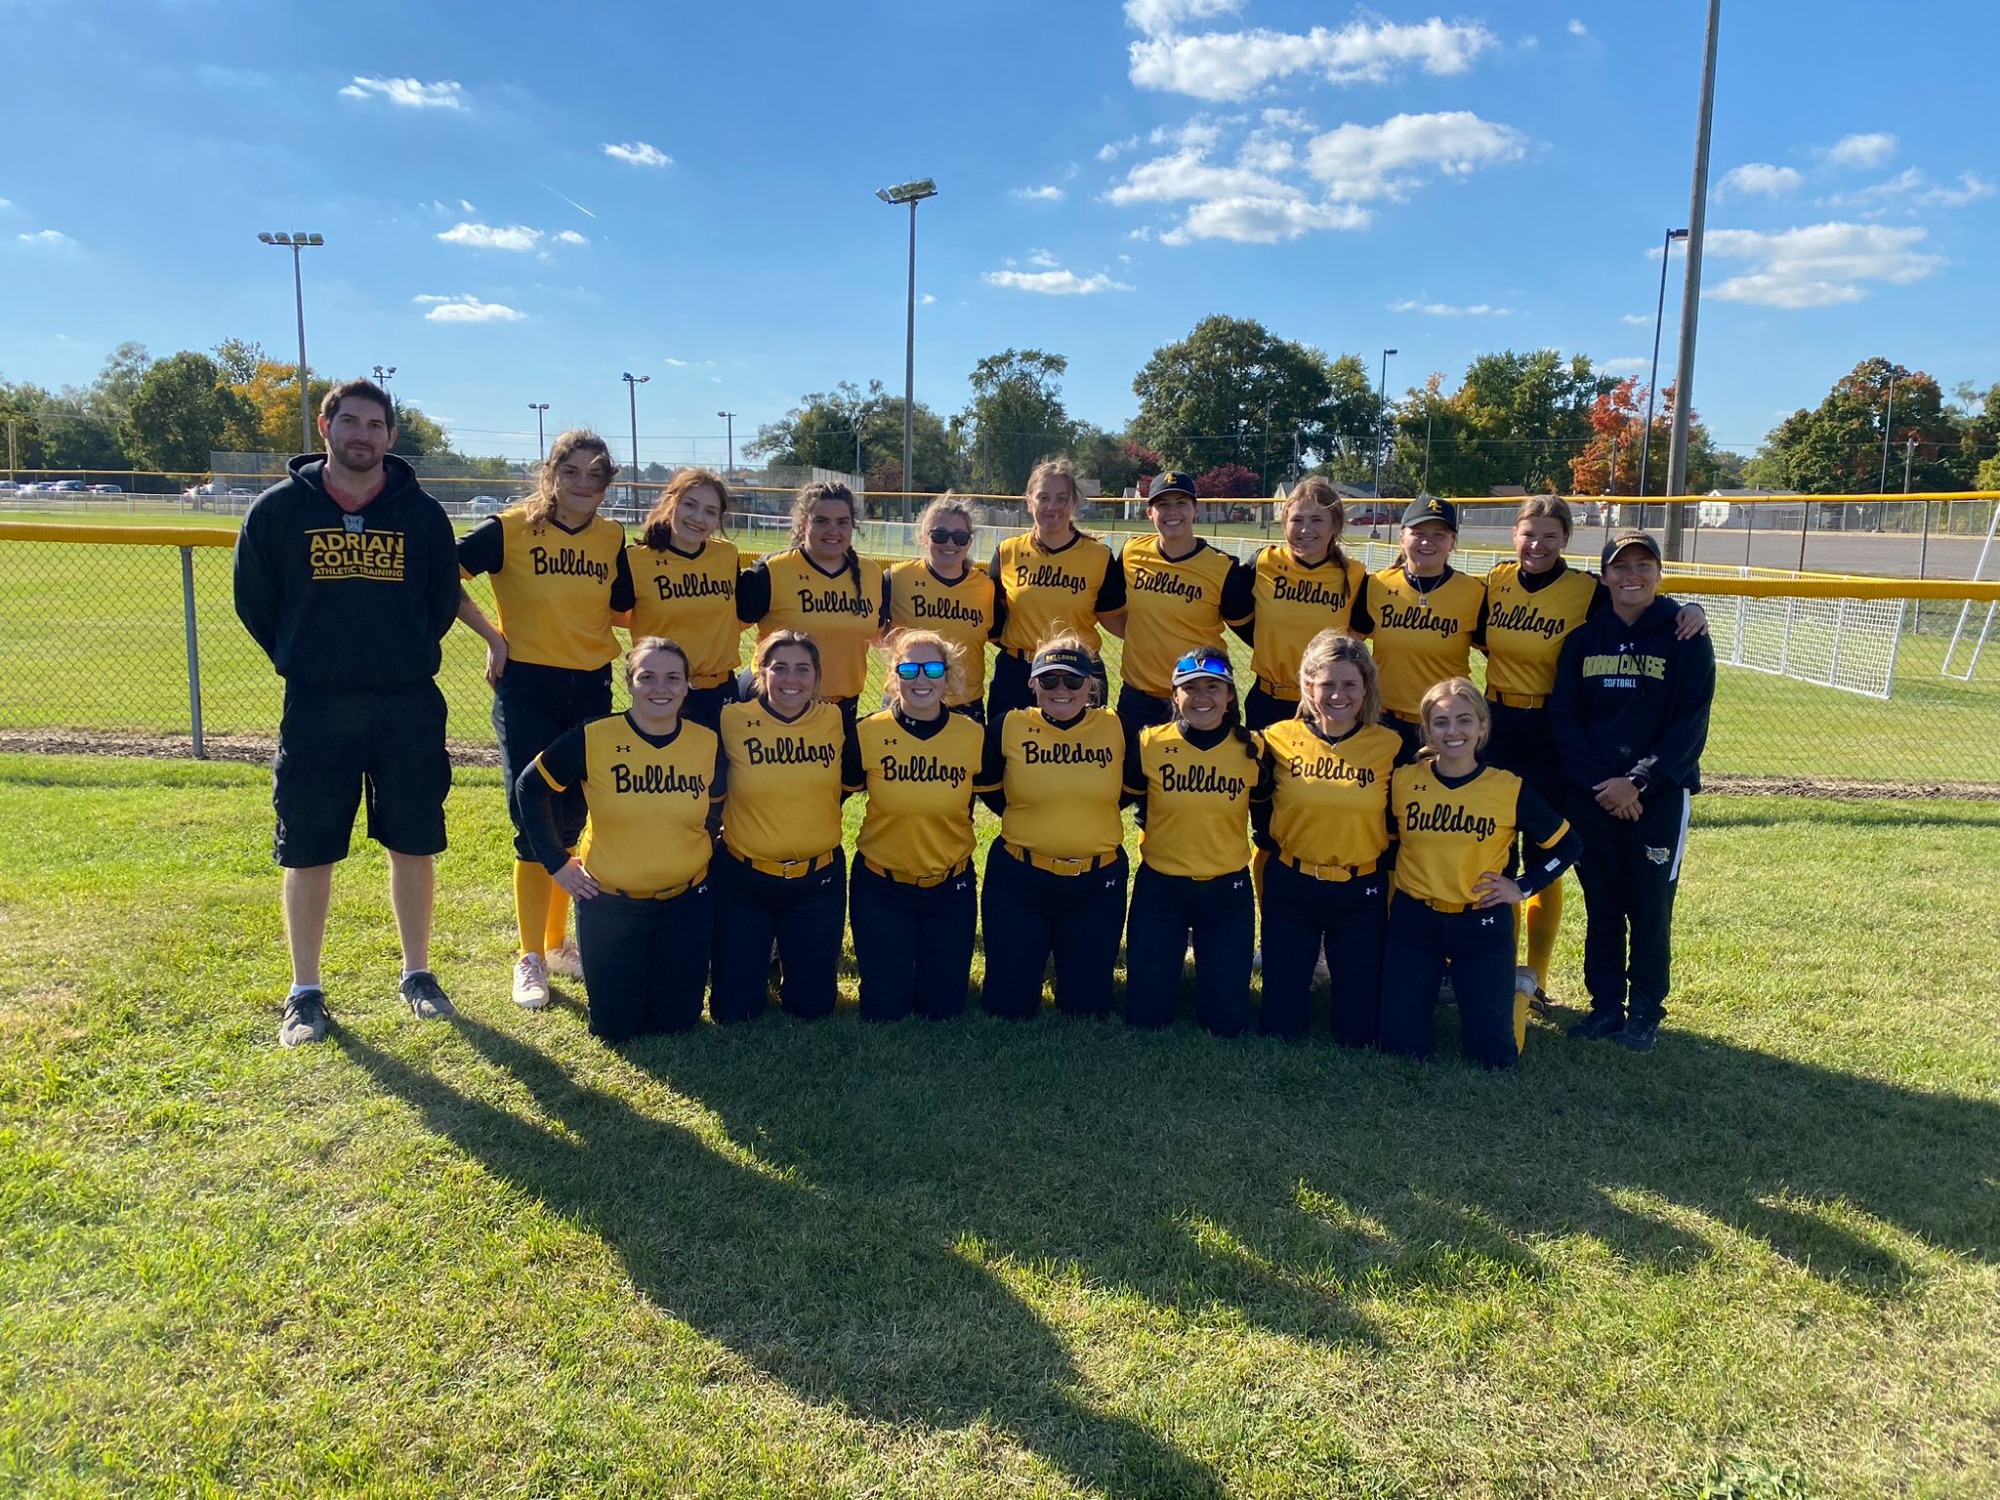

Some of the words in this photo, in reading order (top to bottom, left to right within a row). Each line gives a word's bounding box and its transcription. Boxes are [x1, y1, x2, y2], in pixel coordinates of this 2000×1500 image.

[310, 533, 404, 554] ADRIAN
[310, 550, 405, 569] COLLEGE
[313, 565, 358, 576] ATHLETIC
[359, 566, 404, 577] TRAINING
[530, 546, 608, 585] Bulldogs
[1015, 565, 1086, 594] Bulldogs
[654, 572, 733, 601] Bulldogs
[1134, 569, 1203, 603] Bulldogs
[1273, 575, 1346, 613] Bulldogs
[798, 589, 873, 618] Bulldogs
[912, 594, 984, 626] Bulldogs
[1381, 603, 1459, 638] Bulldogs
[1488, 601, 1565, 640] Bulldogs
[1603, 678, 1637, 688] SOFTBALL
[743, 736, 835, 768] Bulldogs
[1022, 740, 1112, 768] Bulldogs
[611, 763, 706, 799] Bulldogs
[881, 755, 966, 788] Bulldogs
[1159, 763, 1246, 801] Bulldogs
[1289, 755, 1375, 788] Bulldogs
[1406, 801, 1496, 841] Bulldogs
